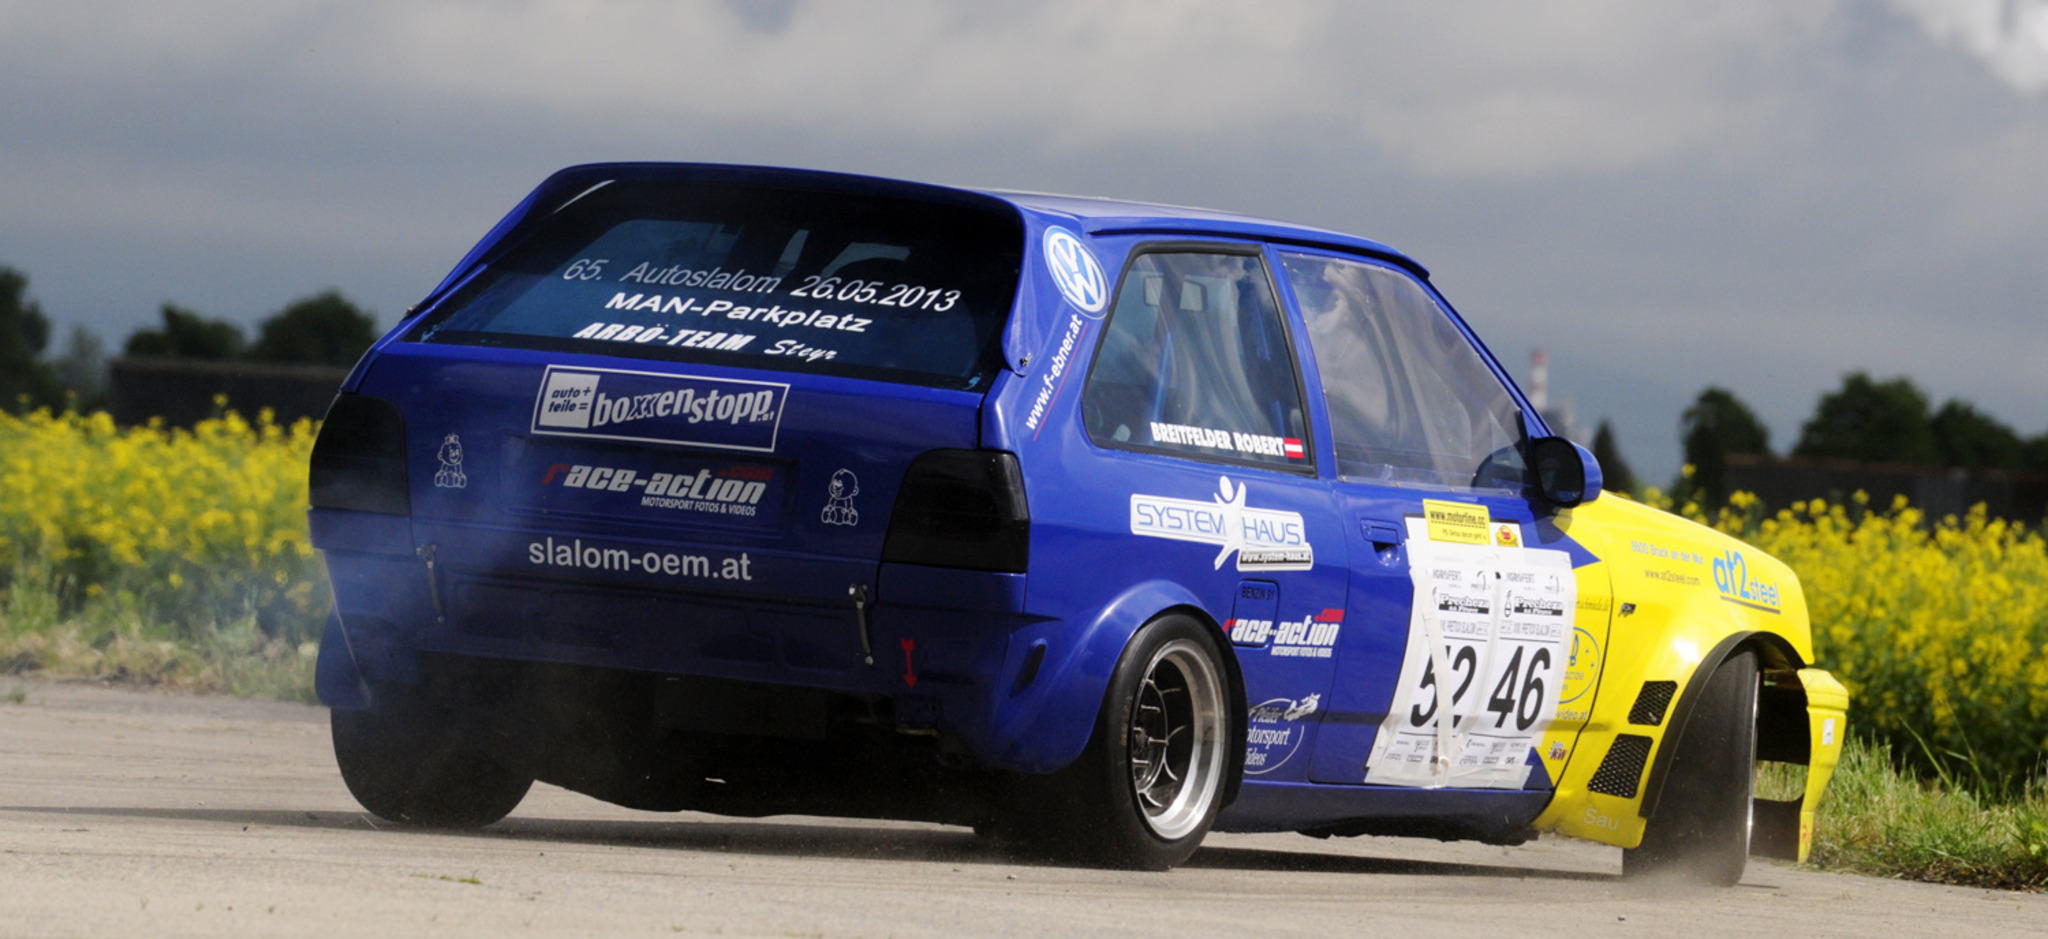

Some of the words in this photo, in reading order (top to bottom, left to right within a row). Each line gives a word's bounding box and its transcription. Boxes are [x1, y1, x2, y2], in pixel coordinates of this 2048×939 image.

[563, 258, 603, 280] 65.
[619, 261, 782, 294] Autoslalom
[790, 275, 962, 312] 26.05.2013
[605, 292, 873, 333] MAN-Parkplatz
[573, 322, 757, 351] ARBÖ-TEAM
[764, 339, 838, 362] Steyr
[1025, 313, 1084, 430] www.f-ebner.at
[549, 400, 577, 412] teile
[552, 386, 580, 398] auto
[1150, 421, 1234, 451] BREITFELDER
[1236, 432, 1285, 456] ROBERT
[641, 496, 694, 510] MOTORSPORT
[695, 501, 719, 513] FOTOS
[720, 504, 727, 513] &
[729, 505, 756, 516] VIDEOS
[1137, 503, 1224, 535] SYSTEM
[1242, 516, 1301, 545] HAUS
[528, 537, 752, 581] slalom-oem.at
[1242, 586, 1265, 600] BENZIN
[1487, 646, 1551, 731] 46
[1246, 726, 1291, 749] otorsport
